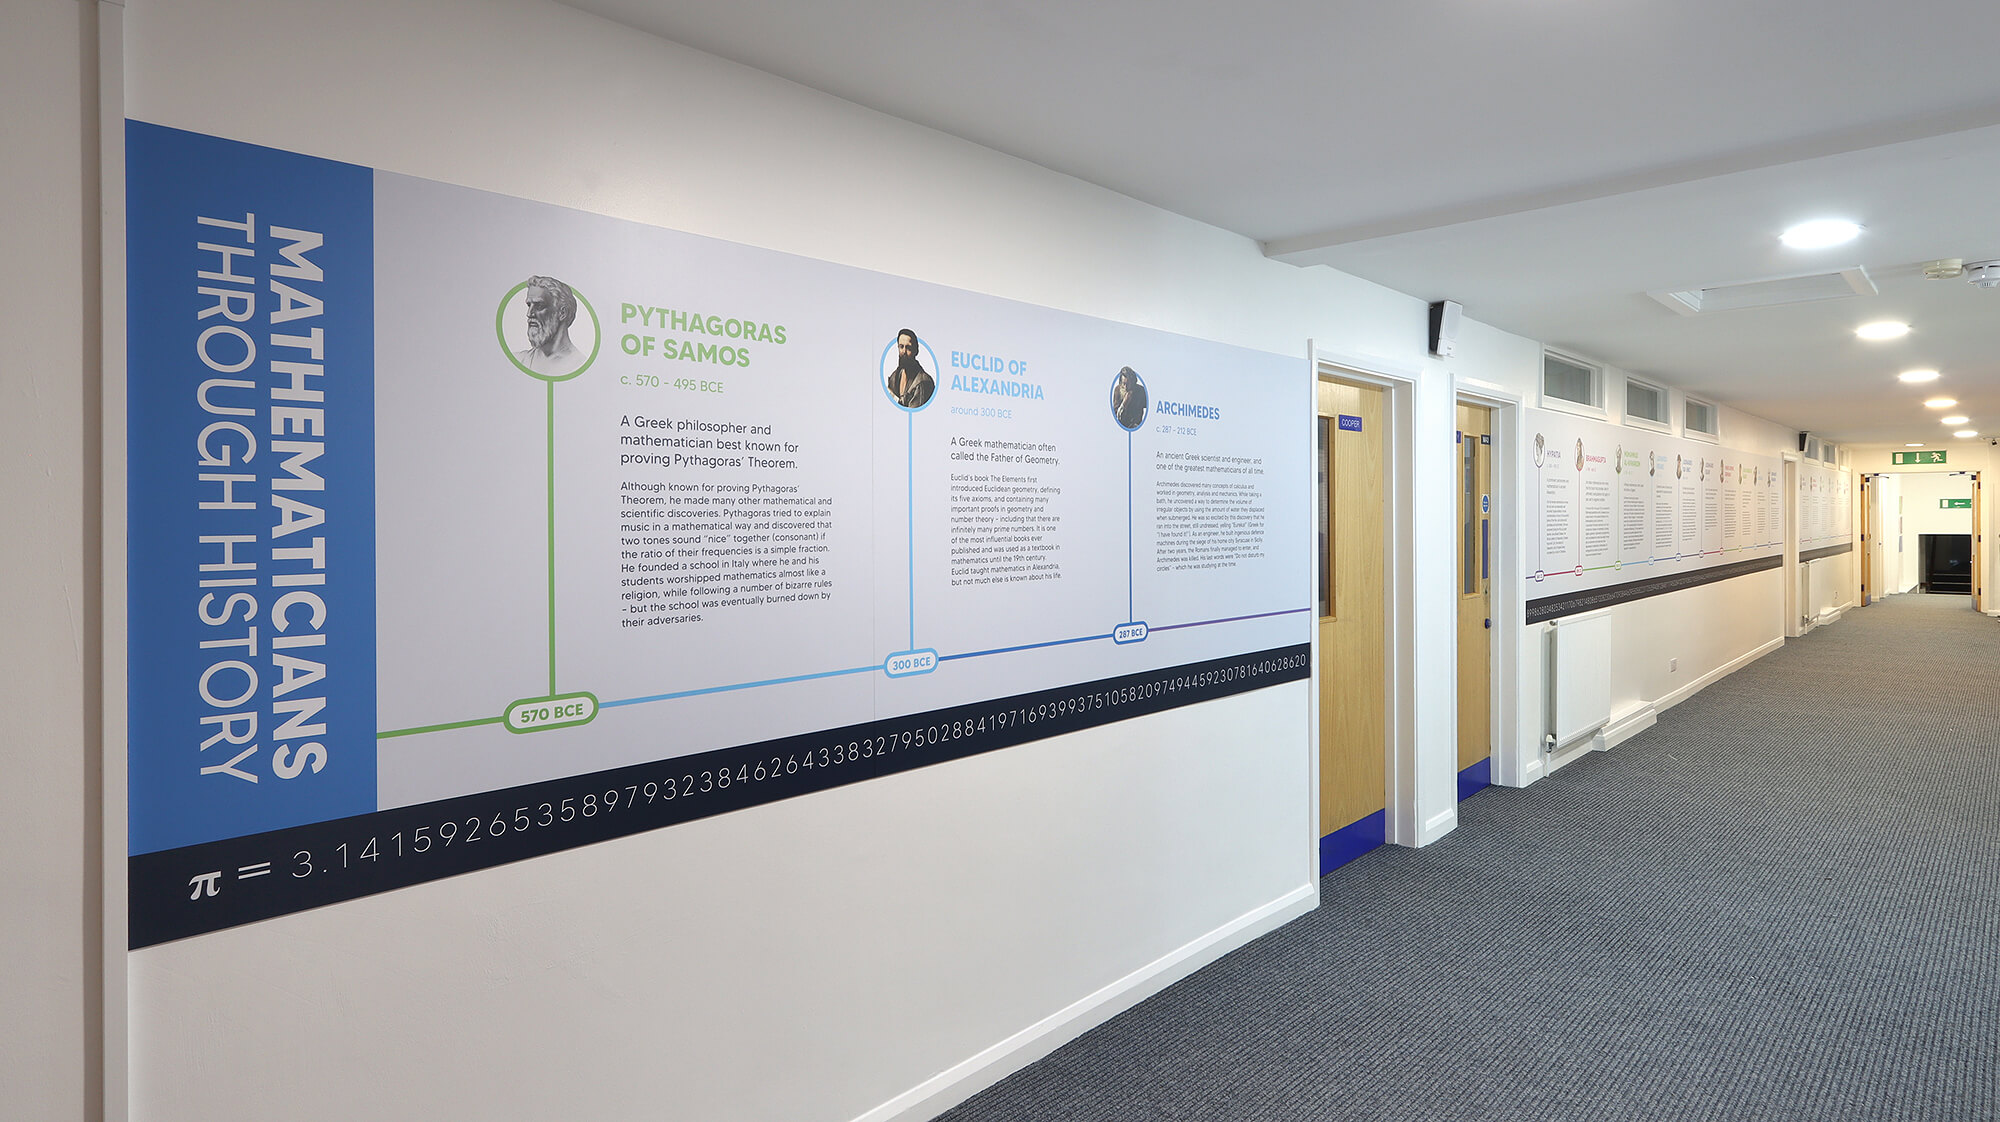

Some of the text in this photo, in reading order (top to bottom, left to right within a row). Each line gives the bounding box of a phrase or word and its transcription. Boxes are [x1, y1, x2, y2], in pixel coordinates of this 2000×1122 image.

[622, 303, 786, 345] PYTHAGORAS
[621, 333, 750, 368] OF SAMOS
[952, 351, 1027, 377] EUCLID OF
[620, 376, 632, 385] c.
[636, 374, 660, 388] 570
[674, 378, 696, 391] 495
[700, 380, 724, 393] BCE
[951, 374, 1044, 400] ALEXANDRIA
[951, 406, 1012, 419] around 300 BCE
[1156, 400, 1220, 420] ARCHIMEDES
[621, 415, 771, 436] A Greek philosopher and
[621, 434, 798, 453] mathematician best known for
[951, 437, 1056, 452] A Greek mathematician often
[621, 454, 670, 467] proving
[748, 457, 798, 469] Theorem.
[950, 451, 1062, 466] called the Father of Geometry.
[620, 482, 666, 493] Although
[668, 483, 699, 491] known
[702, 483, 714, 492] for
[717, 485, 750, 494] proving
[1040, 487, 1061, 495] defining
[197, 212, 259, 784] THROUGH HISTORY
[269, 225, 328, 780] MATHEMATICIANS
[621, 495, 668, 505] Theorem,
[670, 496, 682, 504] he
[684, 496, 710, 504] made
[712, 498, 736, 506] many
[738, 497, 761, 505] other
[763, 497, 816, 505] mathematical
[621, 524, 650, 532] music
[652, 523, 661, 531] in
[672, 522, 733, 531] mathematical
[735, 523, 752, 531] way
[754, 522, 770, 530] and
[643, 537, 670, 545] tones
[672, 536, 701, 544] sound
[733, 535, 770, 544] together
[772, 533, 819, 542] (consonant)
[821, 532, 826, 540] if
[621, 564, 635, 573] He
[638, 562, 679, 572] founded
[690, 561, 720, 570] school
[722, 560, 730, 568] in
[732, 559, 750, 569] Italy
[752, 559, 778, 567] where
[779, 558, 790, 566] he
[792, 557, 807, 565] and
[808, 557, 819, 565] his
[951, 567, 969, 576] Euclid
[970, 567, 990, 576] taught
[990, 565, 1025, 573] mathematics
[630, 604, 647, 613] but
[650, 602, 666, 612] the
[669, 600, 699, 611] school
[721, 596, 764, 607] eventually
[766, 594, 796, 603] burned
[798, 592, 820, 601] down
[821, 592, 831, 600] by
[622, 614, 704, 628] their adversaries.
[1119, 628, 1143, 639] 287 BCE
[893, 656, 931, 671] 300 BCE
[521, 703, 584, 724] 570 BCE
[188, 871, 222, 901] π
